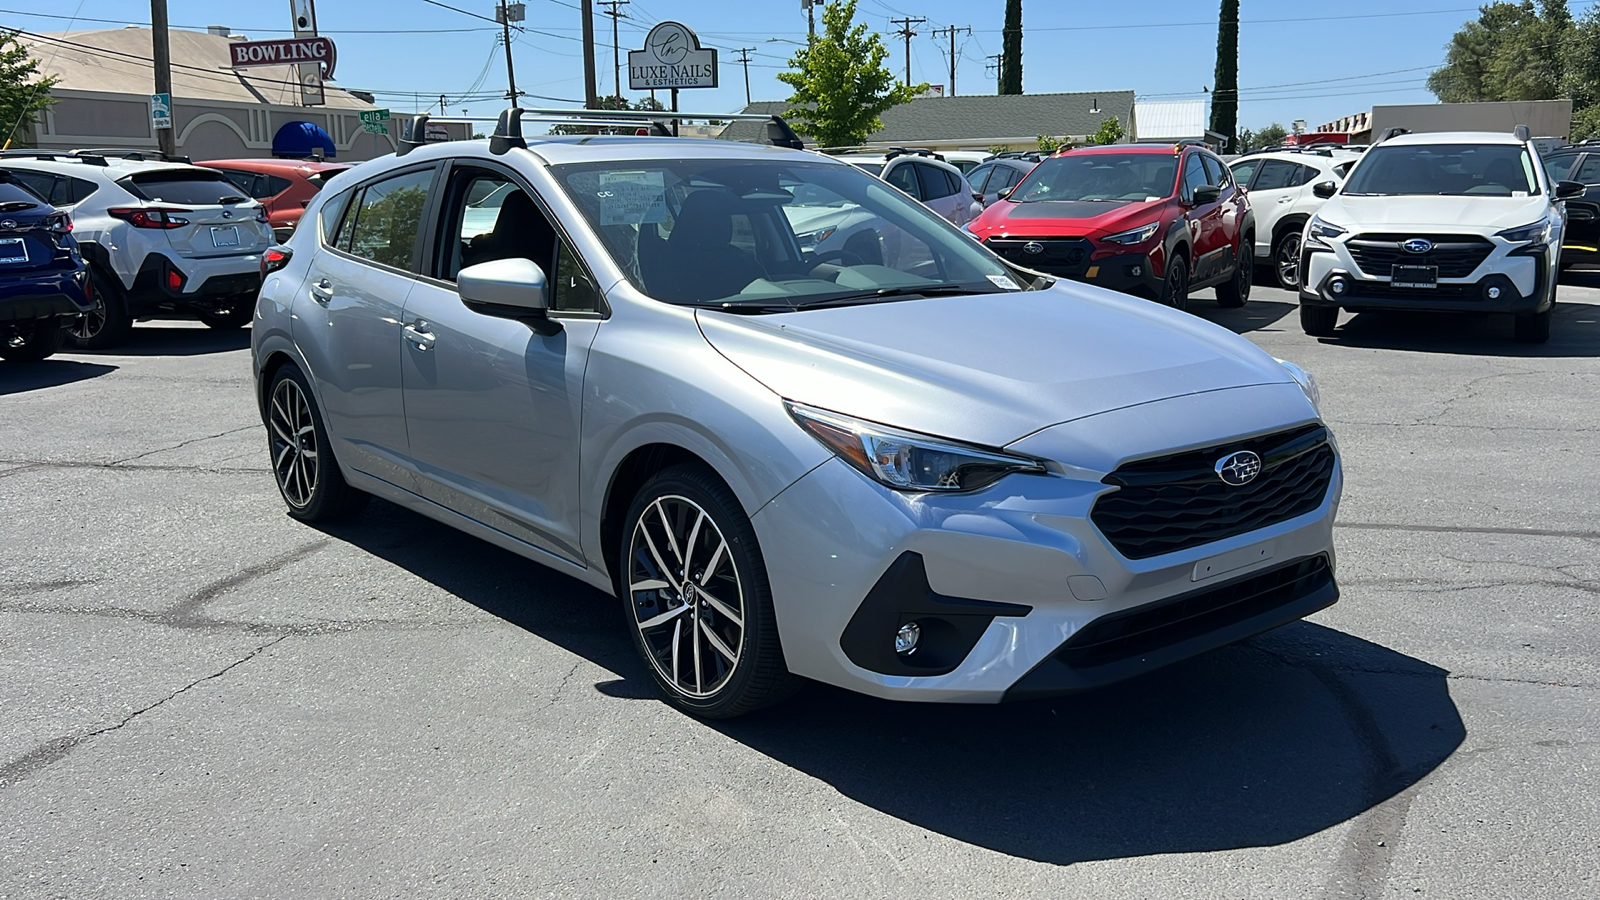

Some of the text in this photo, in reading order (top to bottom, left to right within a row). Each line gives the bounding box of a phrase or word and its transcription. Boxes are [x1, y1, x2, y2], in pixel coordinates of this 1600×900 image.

[236, 41, 327, 62] BOWLING
[632, 64, 712, 79] LUXE NAILS
[653, 77, 699, 86] ESTHETICS
